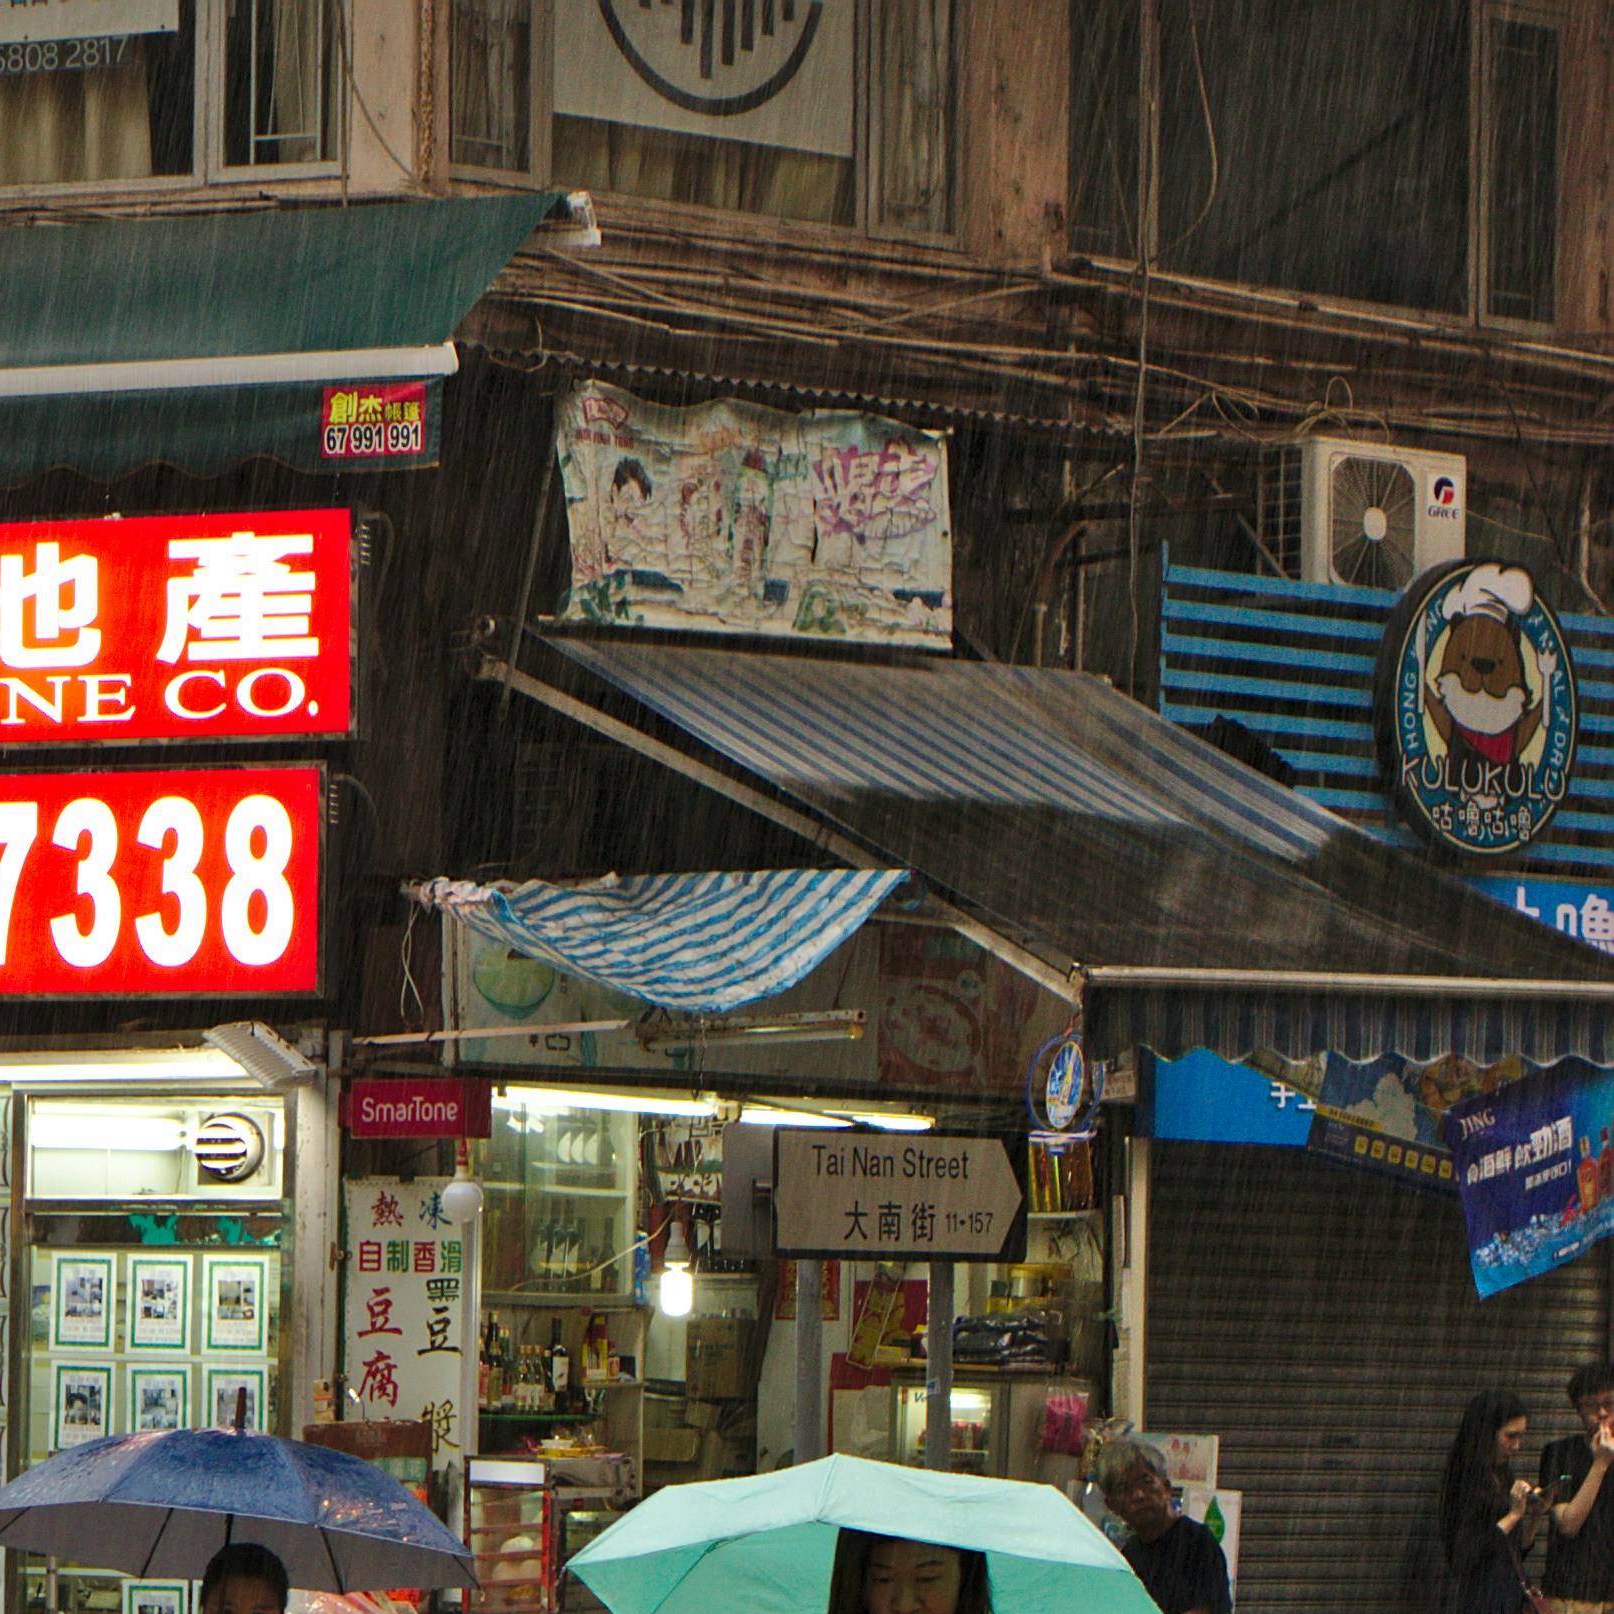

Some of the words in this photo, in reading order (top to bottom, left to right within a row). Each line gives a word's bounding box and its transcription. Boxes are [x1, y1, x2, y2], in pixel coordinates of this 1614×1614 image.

[65, 37, 128, 68] 2817
[325, 425, 349, 454] 67
[351, 424, 384, 453] 991
[388, 421, 421, 452] 991
[163, 667, 319, 720] CO.
[1402, 754, 1566, 802] KULUKULU
[362, 1096, 458, 1123] SmarTone
[1459, 1108, 1496, 1140] JING
[812, 1145, 845, 1176] Tai
[853, 1147, 894, 1178] Nan
[902, 1147, 969, 1180] Street
[844, 1201, 936, 1243] 大南街
